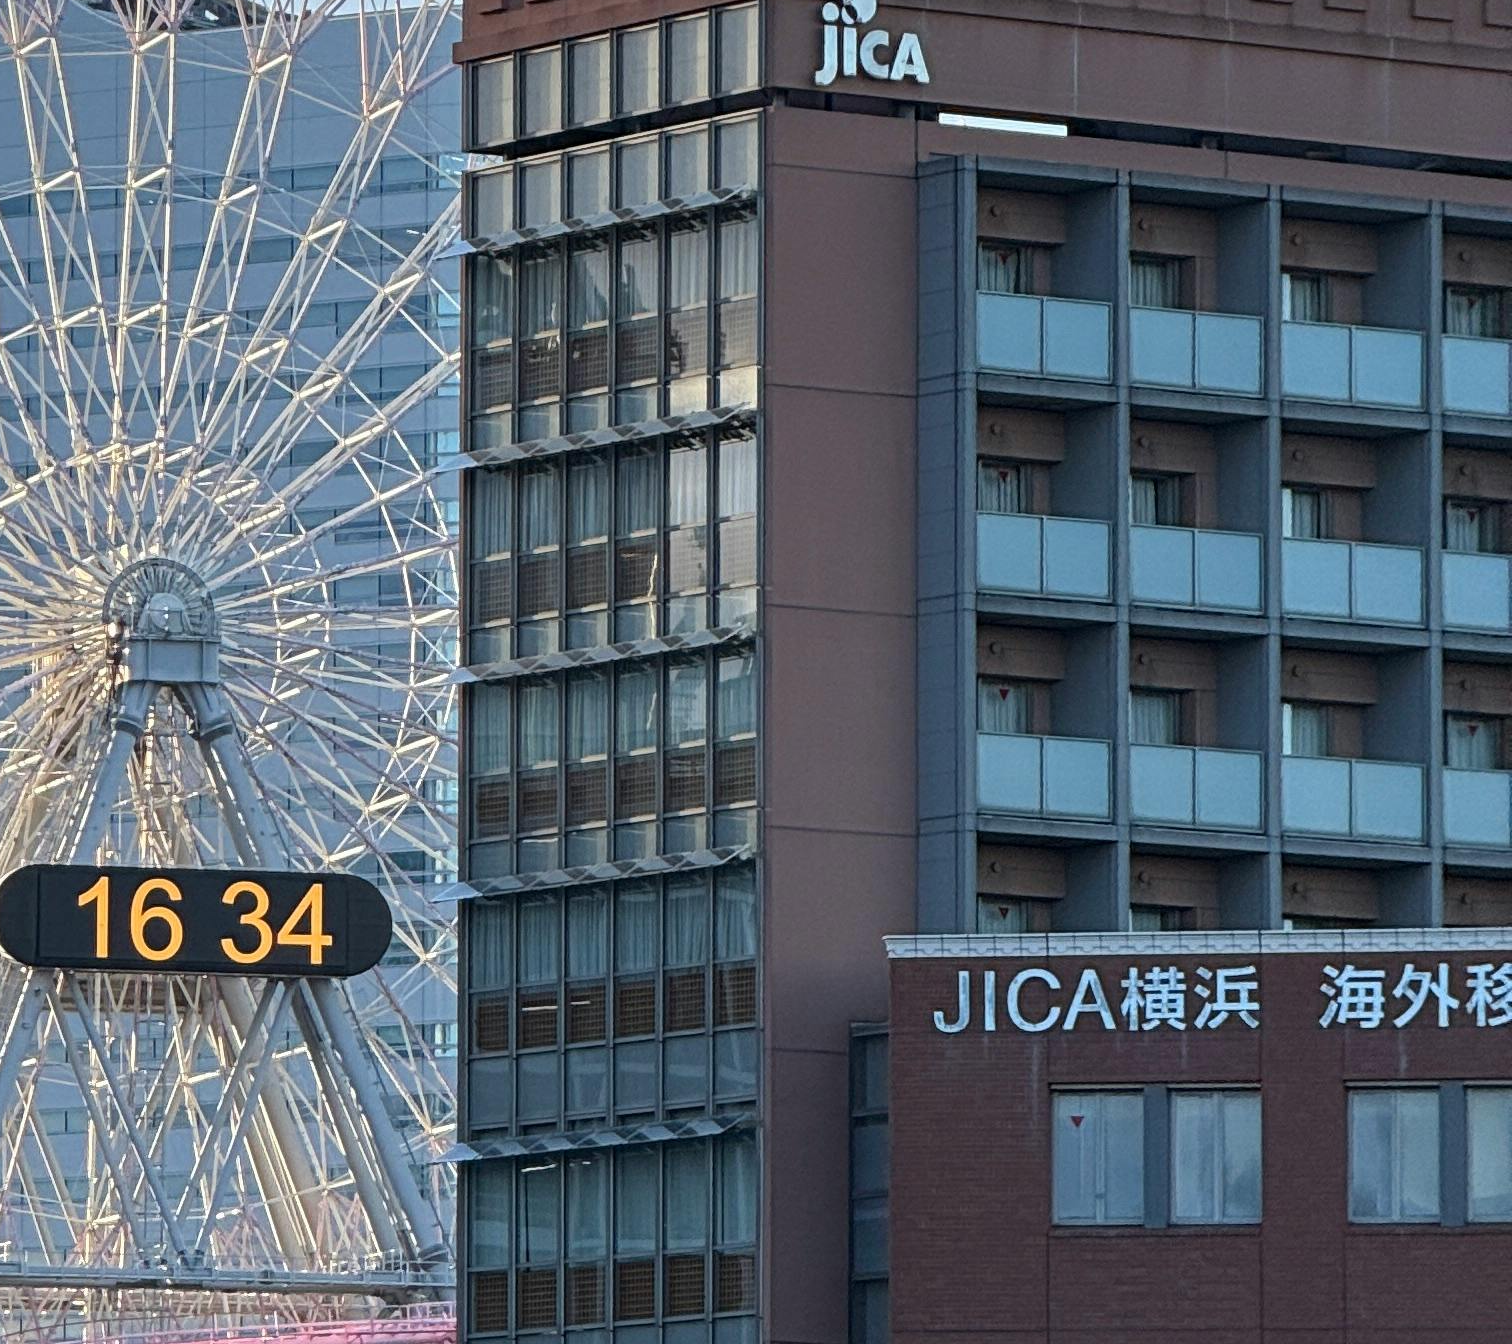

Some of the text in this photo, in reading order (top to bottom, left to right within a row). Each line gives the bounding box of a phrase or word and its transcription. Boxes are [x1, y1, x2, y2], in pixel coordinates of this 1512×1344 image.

[77, 875, 333, 965] 16 34
[933, 964, 1261, 1033] JICA横浜
